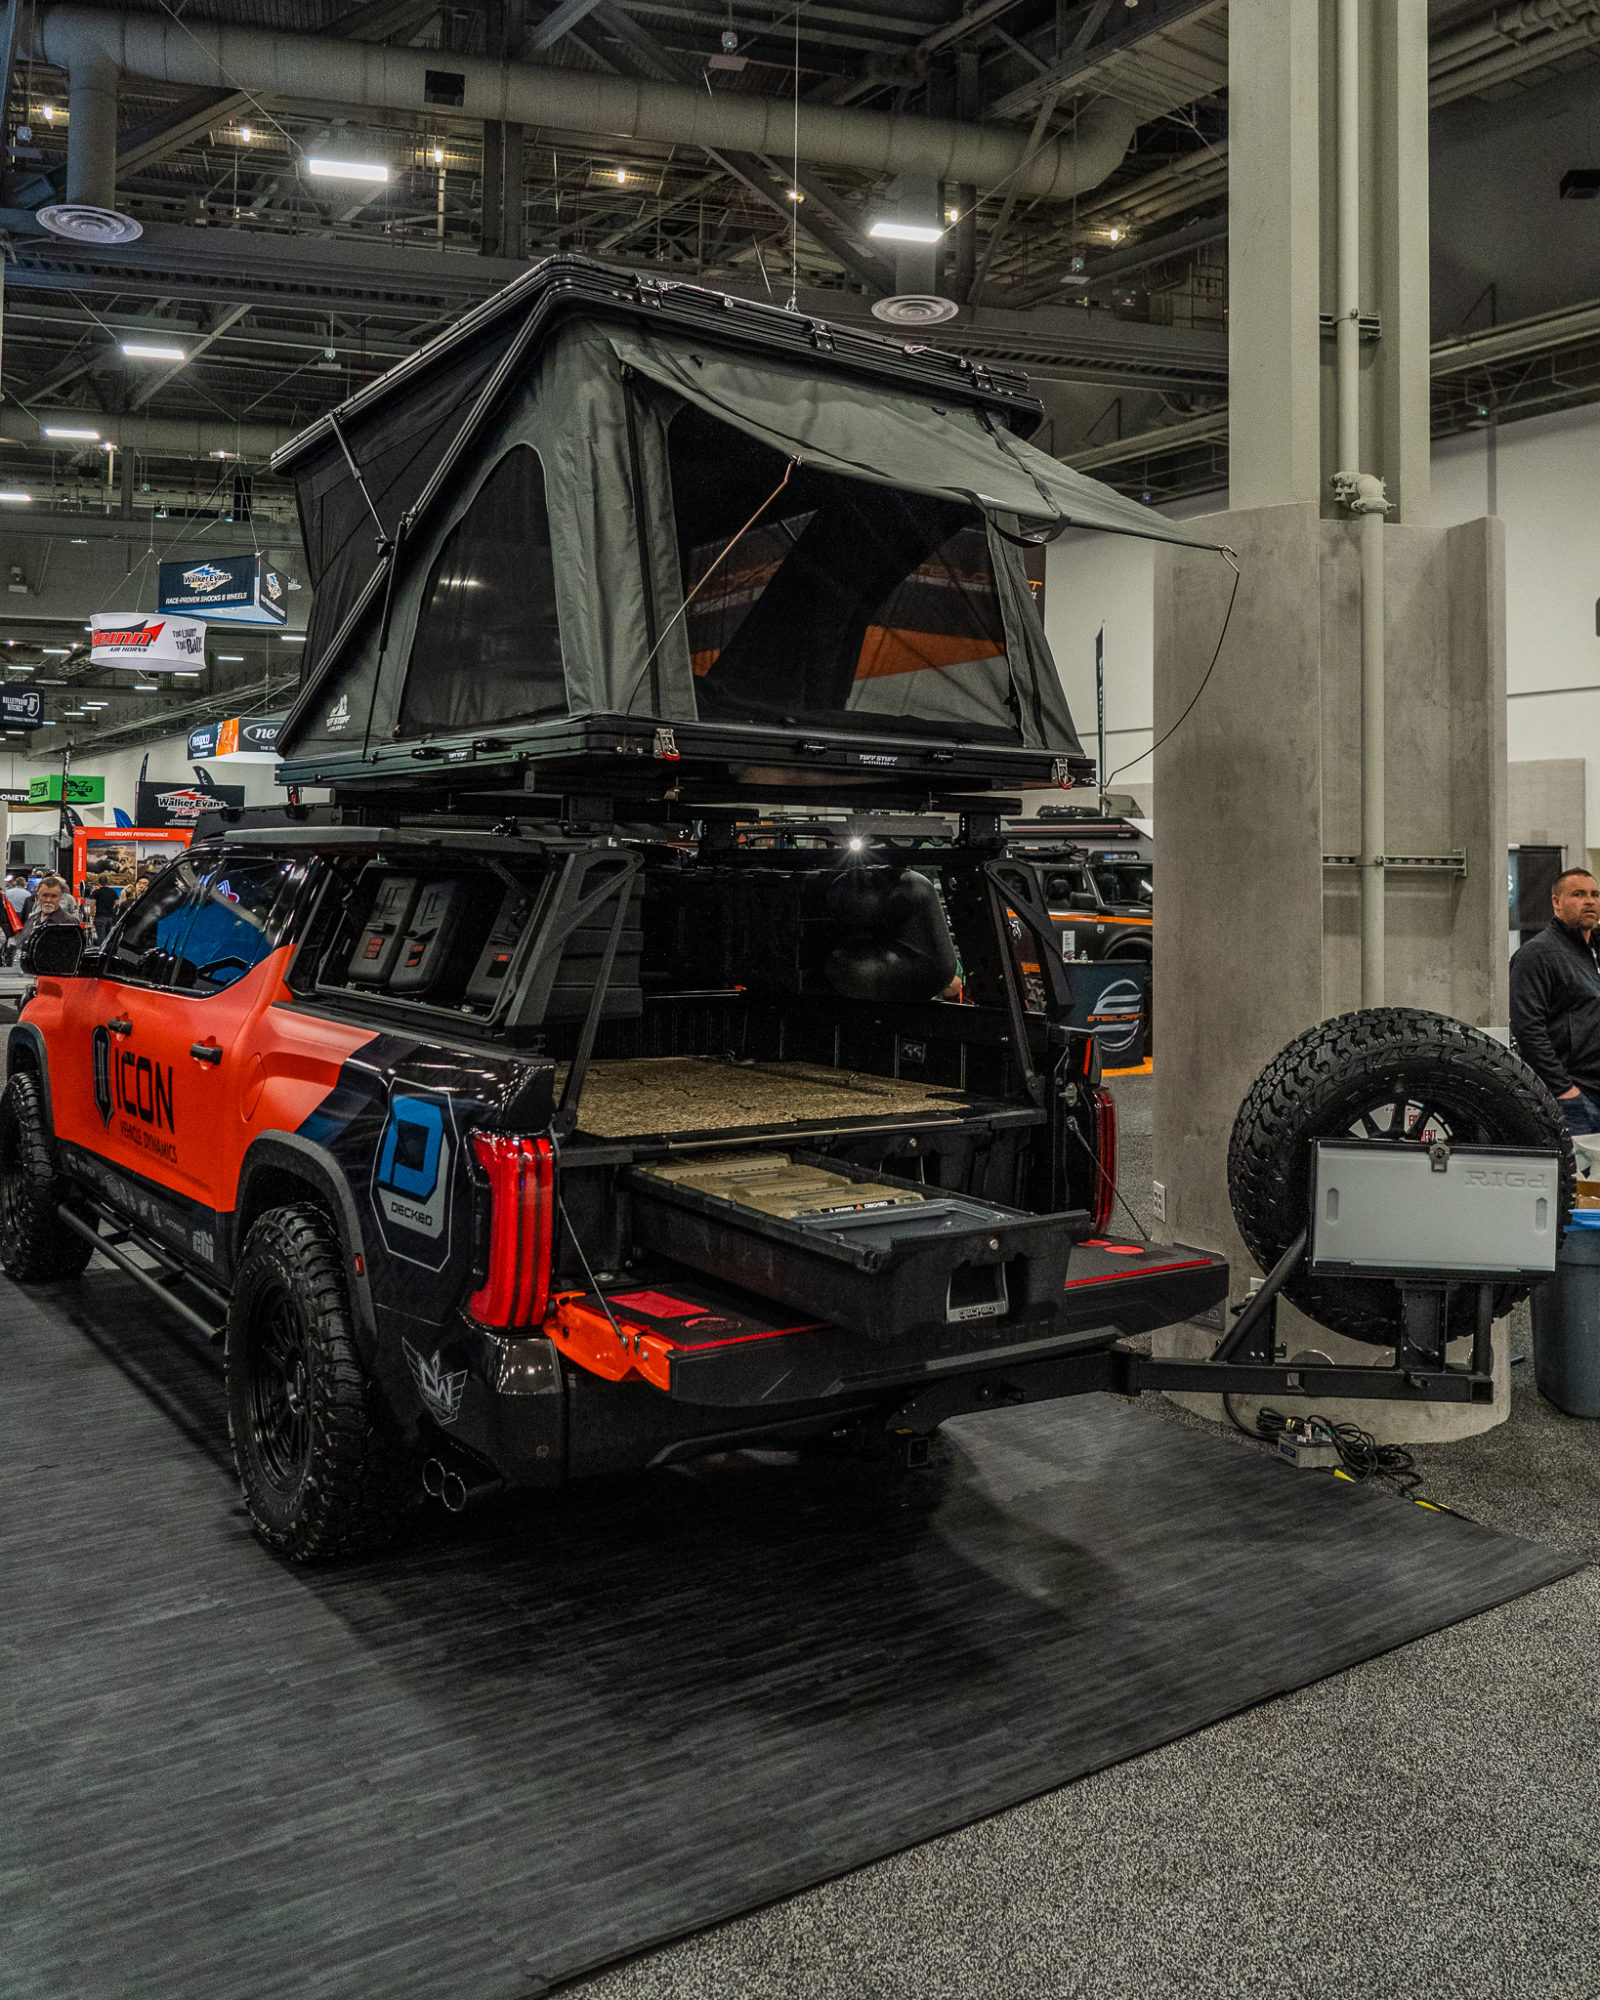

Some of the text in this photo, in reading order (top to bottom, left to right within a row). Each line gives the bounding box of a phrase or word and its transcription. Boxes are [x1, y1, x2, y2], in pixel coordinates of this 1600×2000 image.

[159, 798, 194, 808] Walker
[115, 1047, 174, 1136] ICON
[120, 1120, 178, 1165] VEHICLE DYNAMICS
[391, 1201, 433, 1227] DECKED
